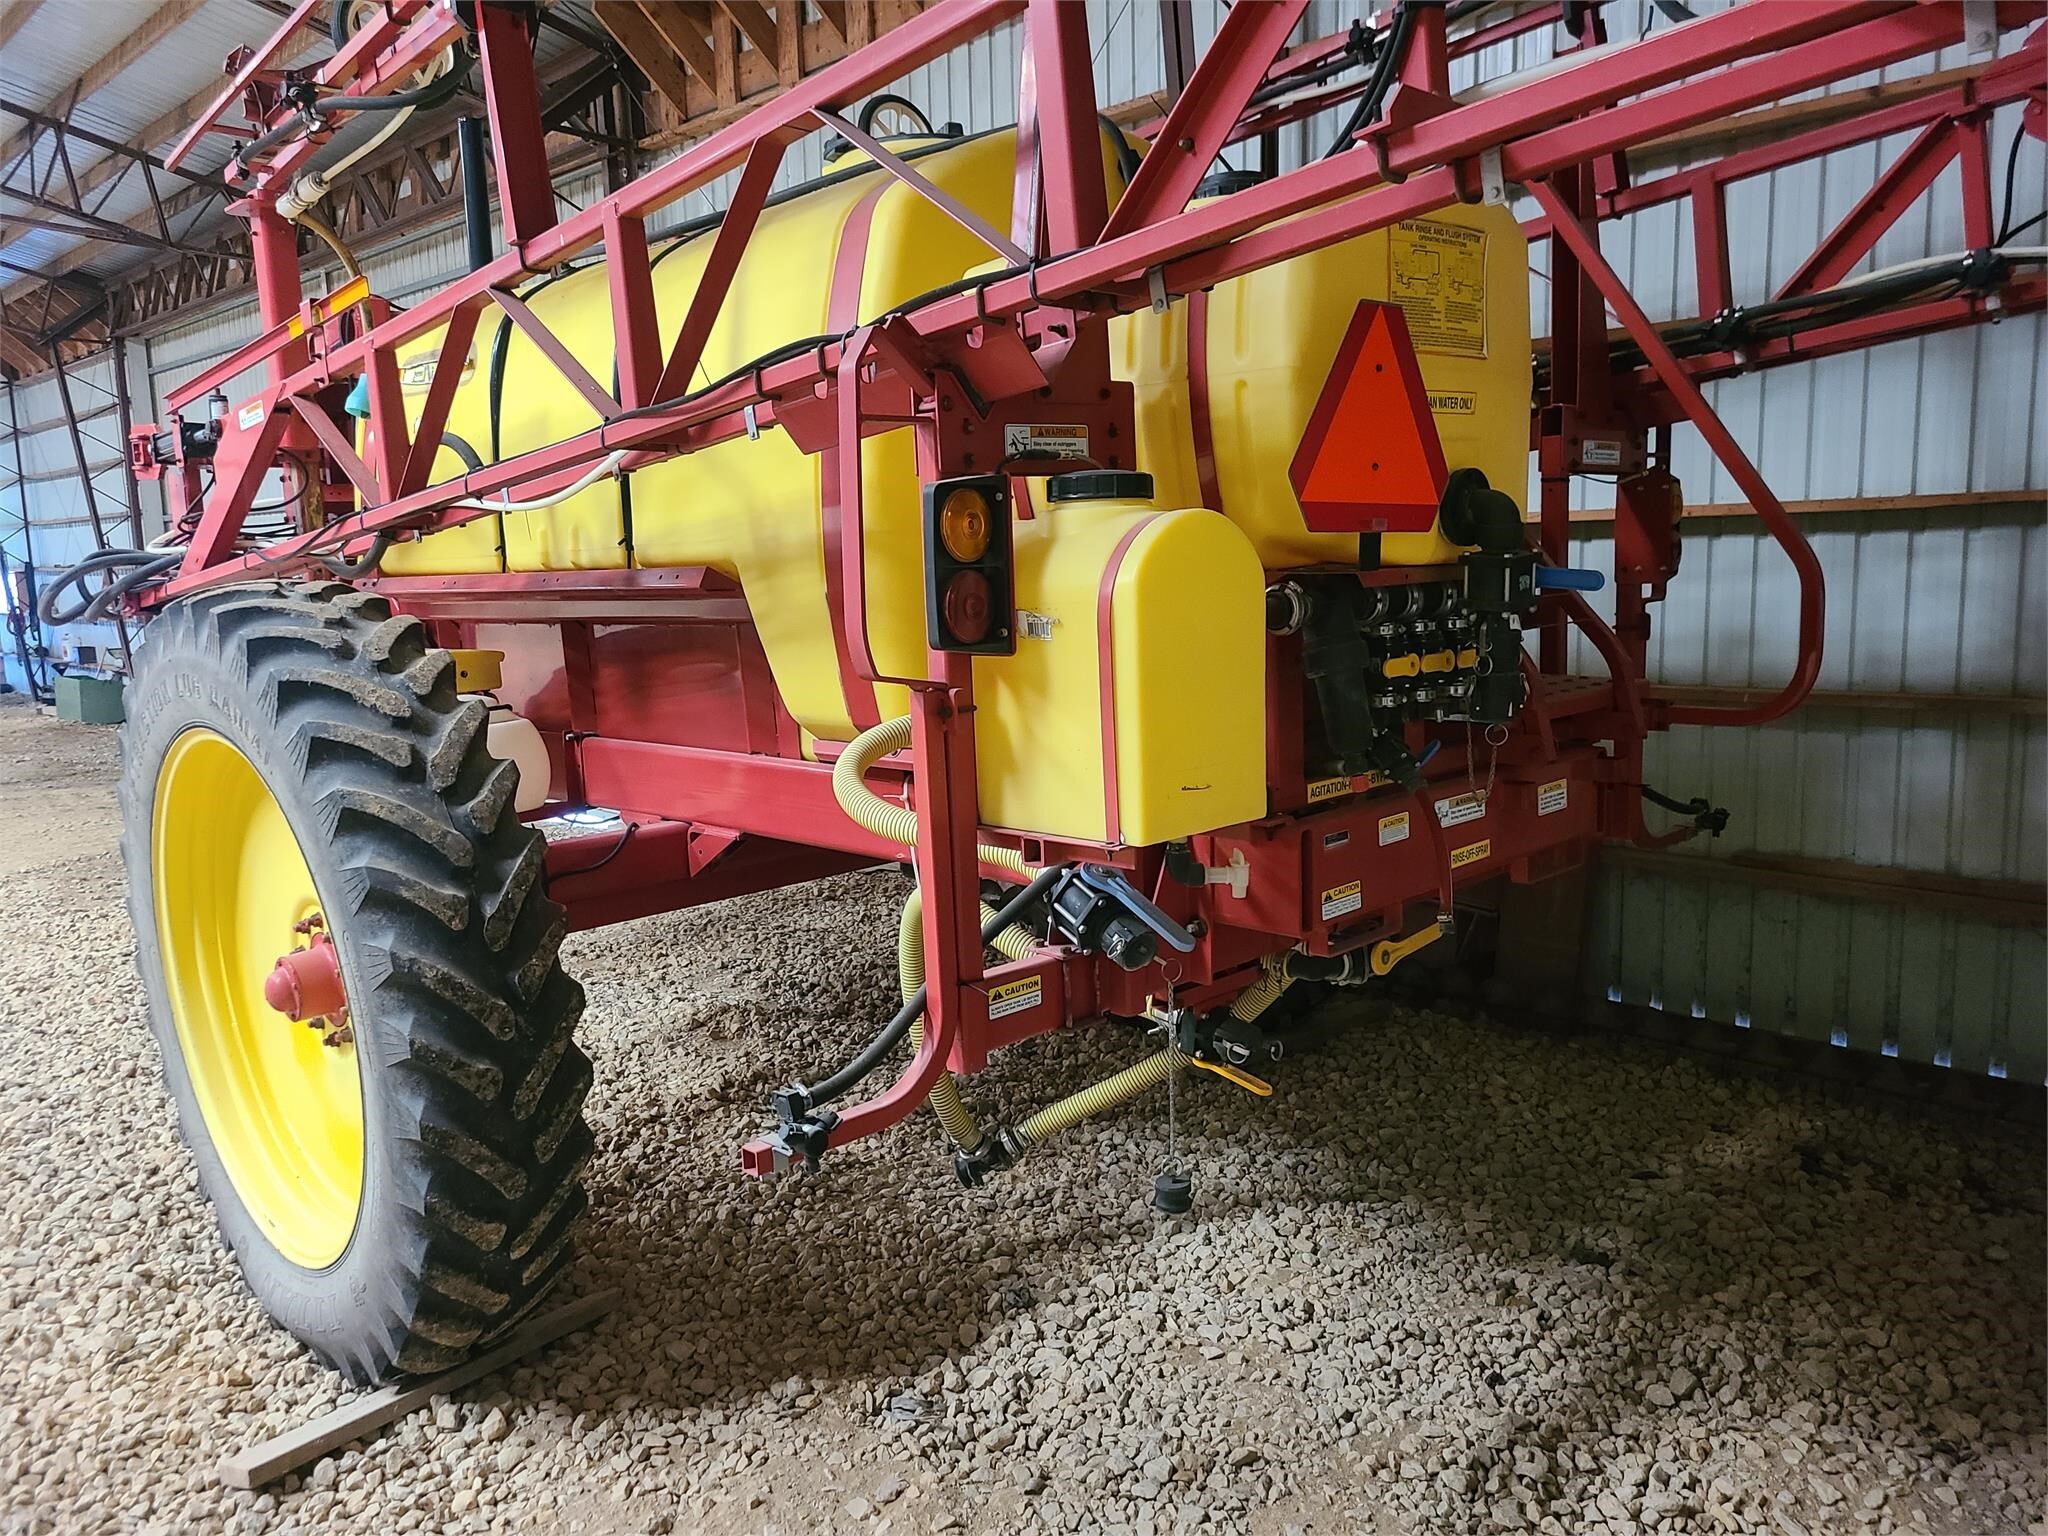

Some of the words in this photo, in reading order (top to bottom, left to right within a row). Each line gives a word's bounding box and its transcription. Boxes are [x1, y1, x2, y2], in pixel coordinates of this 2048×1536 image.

[1398, 222, 1414, 231] TANK
[1415, 224, 1433, 235] RINSE
[1433, 227, 1445, 237] AND
[1445, 228, 1461, 240] FLUSH
[1438, 396, 1459, 409] WATER
[1044, 427, 1077, 437] WARNING
[1333, 882, 1360, 897] CAUTION
[1004, 979, 1040, 996] CAUTION
